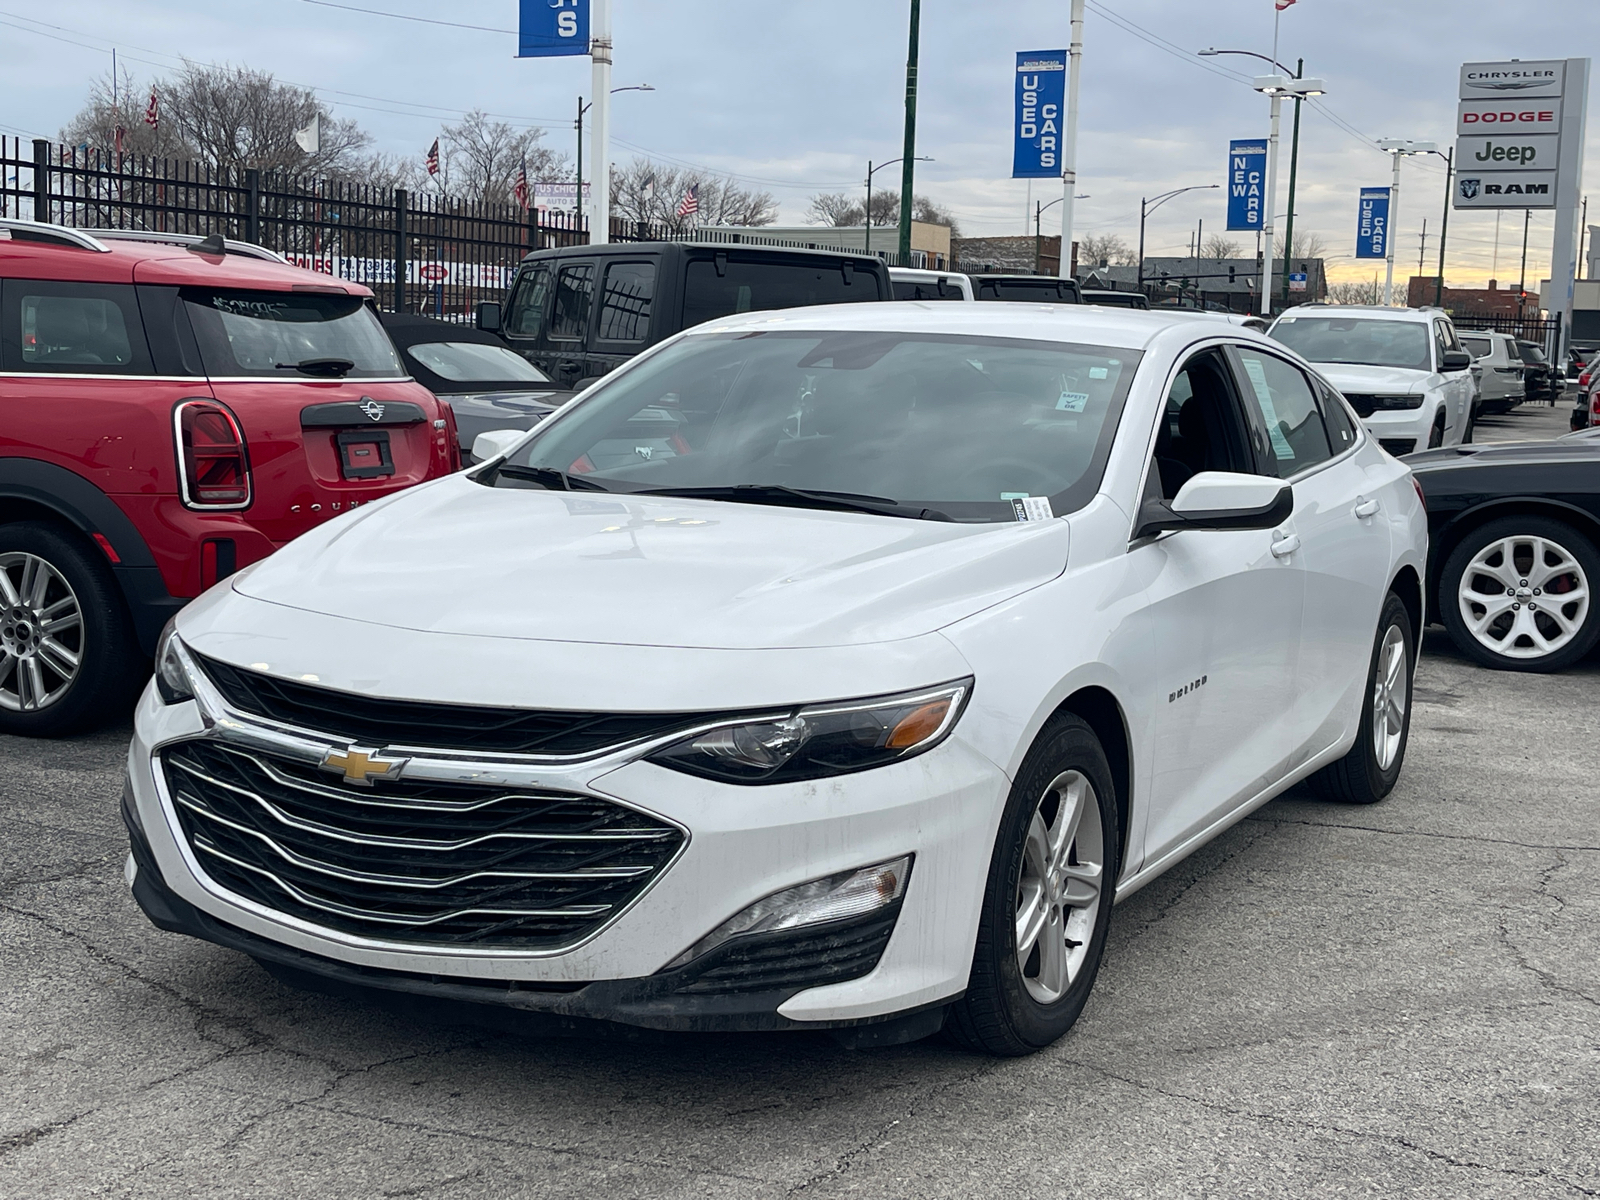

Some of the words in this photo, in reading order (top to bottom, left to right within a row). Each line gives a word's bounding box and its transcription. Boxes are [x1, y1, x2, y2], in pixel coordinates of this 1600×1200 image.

[1467, 70, 1555, 80] CHRYSLER
[1020, 75, 1039, 139] USED
[1463, 111, 1554, 124] DODGE
[1040, 104, 1058, 167] CARS
[1475, 141, 1536, 166] Jeep
[1232, 157, 1247, 198] NEW
[1484, 184, 1549, 195] RAM
[1246, 171, 1260, 224] CARS
[1361, 200, 1374, 237] USED
[1372, 217, 1385, 254] CARS
